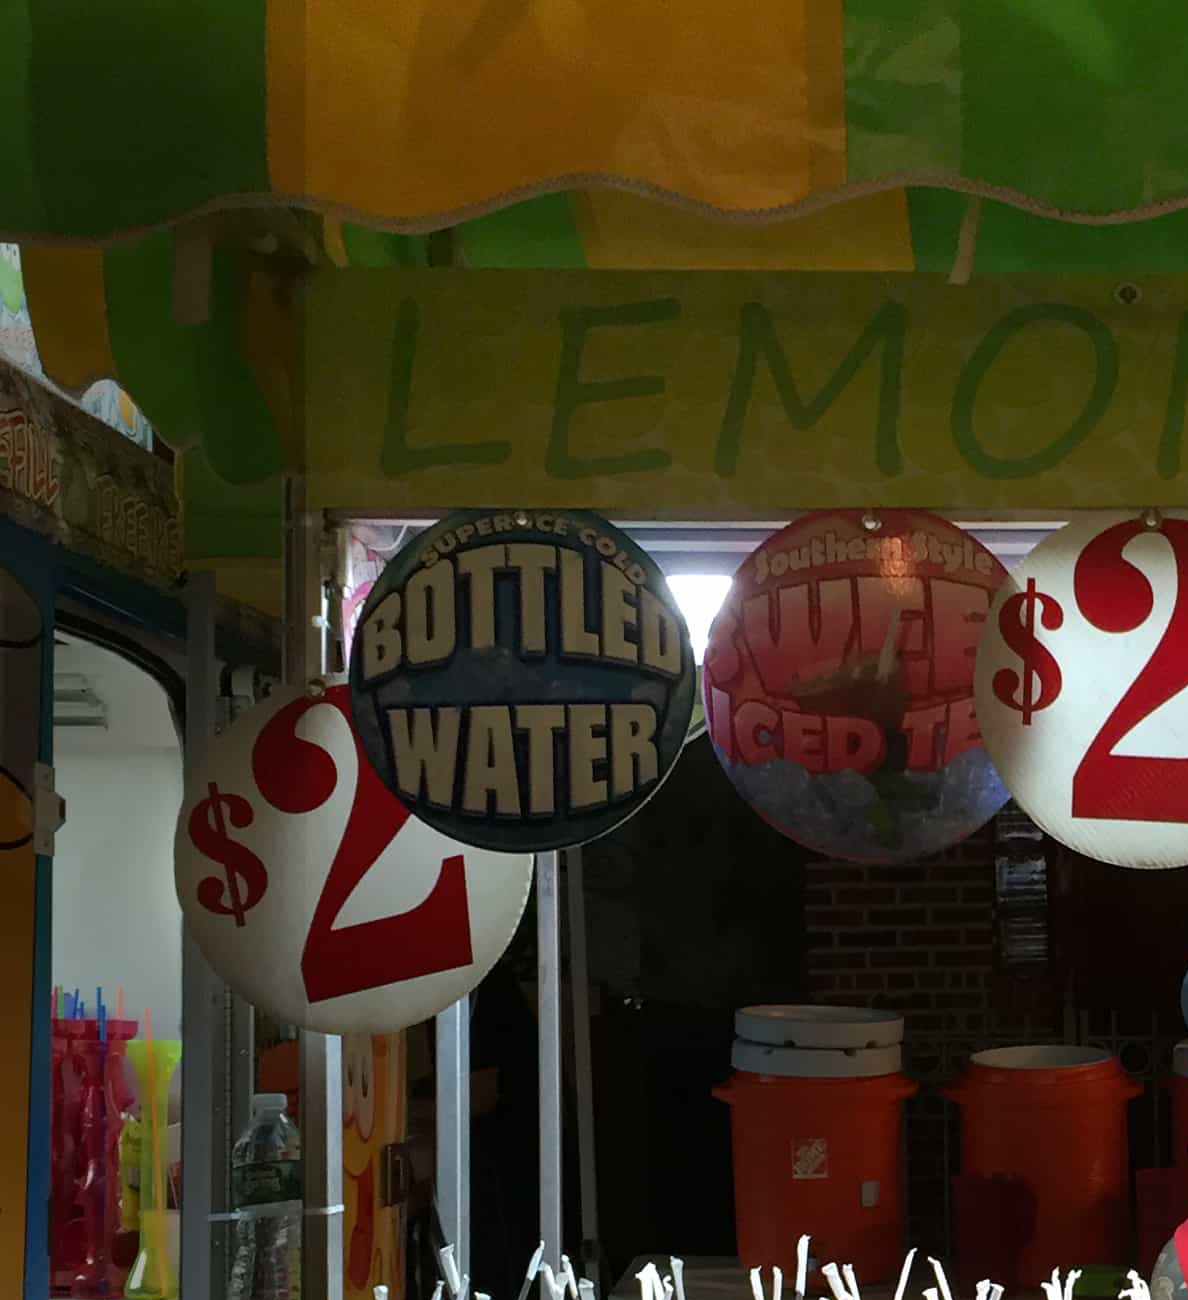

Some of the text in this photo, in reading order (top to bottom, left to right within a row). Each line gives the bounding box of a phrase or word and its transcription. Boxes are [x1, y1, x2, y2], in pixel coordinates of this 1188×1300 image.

[420, 513, 648, 585] SUPER CE COLD
[754, 529, 994, 585] Southern Style
[362, 542, 683, 681] BOTTLED
[704, 575, 990, 699] SWEE
[386, 703, 659, 815] WATER
[901, 696, 986, 773] TE
[188, 683, 474, 1004] $2
